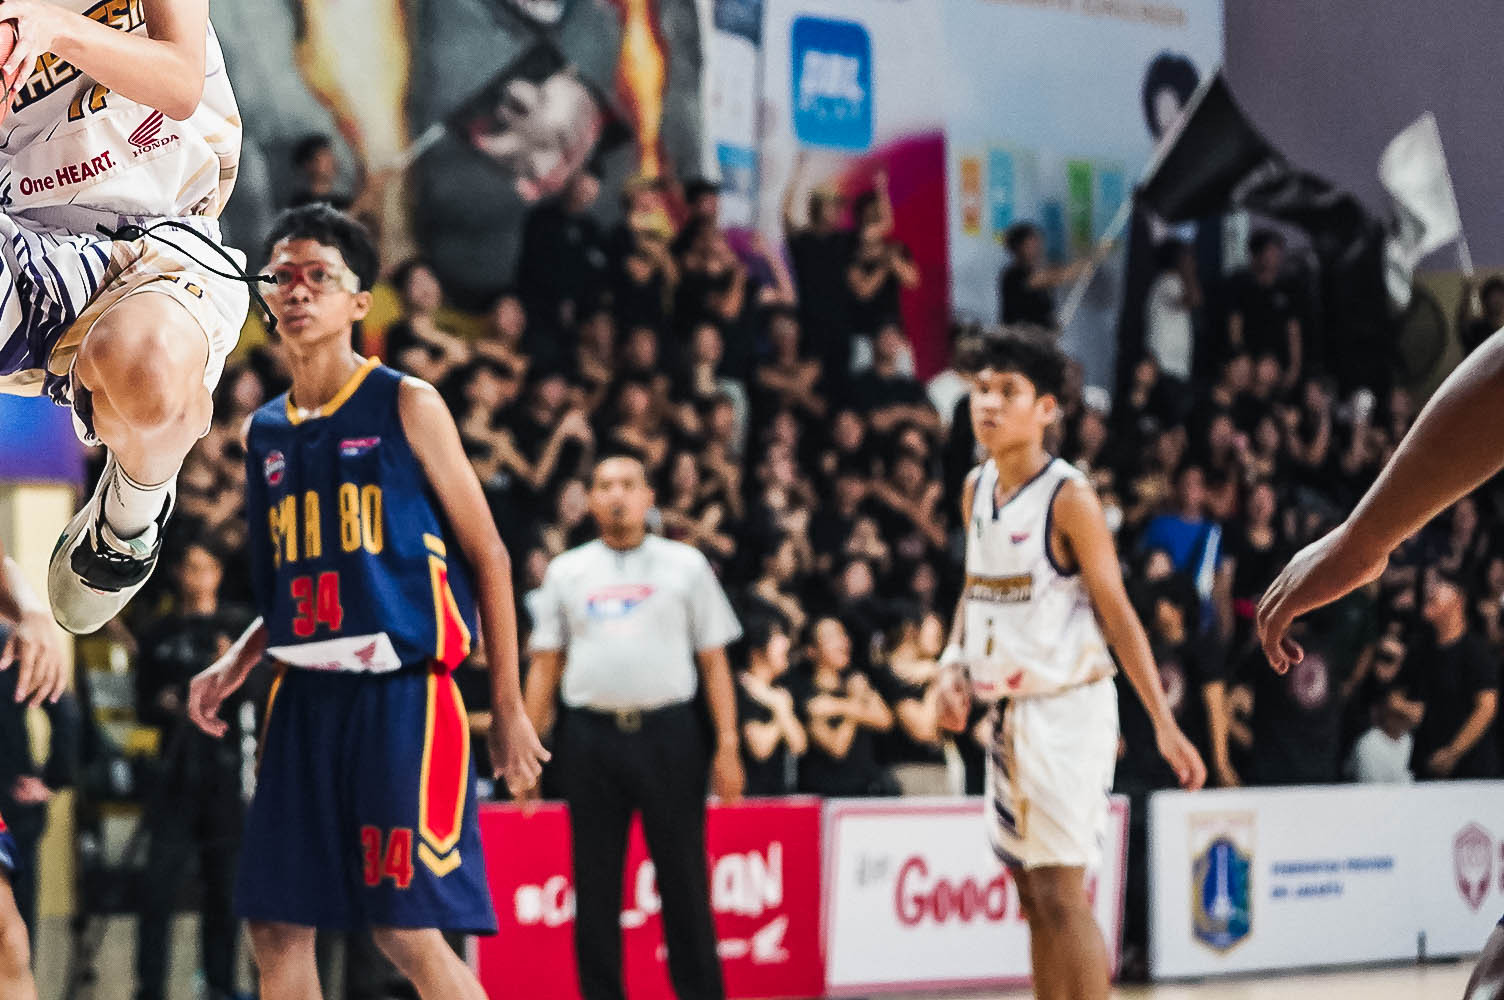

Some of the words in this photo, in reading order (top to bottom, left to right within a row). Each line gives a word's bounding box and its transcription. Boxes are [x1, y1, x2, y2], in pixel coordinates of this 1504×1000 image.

[19, 176, 55, 195] One
[55, 151, 116, 187] HEART.
[133, 134, 180, 157] HONDA
[339, 482, 384, 555] 80
[291, 571, 343, 637] 34
[361, 826, 414, 888] 34
[894, 855, 1026, 925] Good
